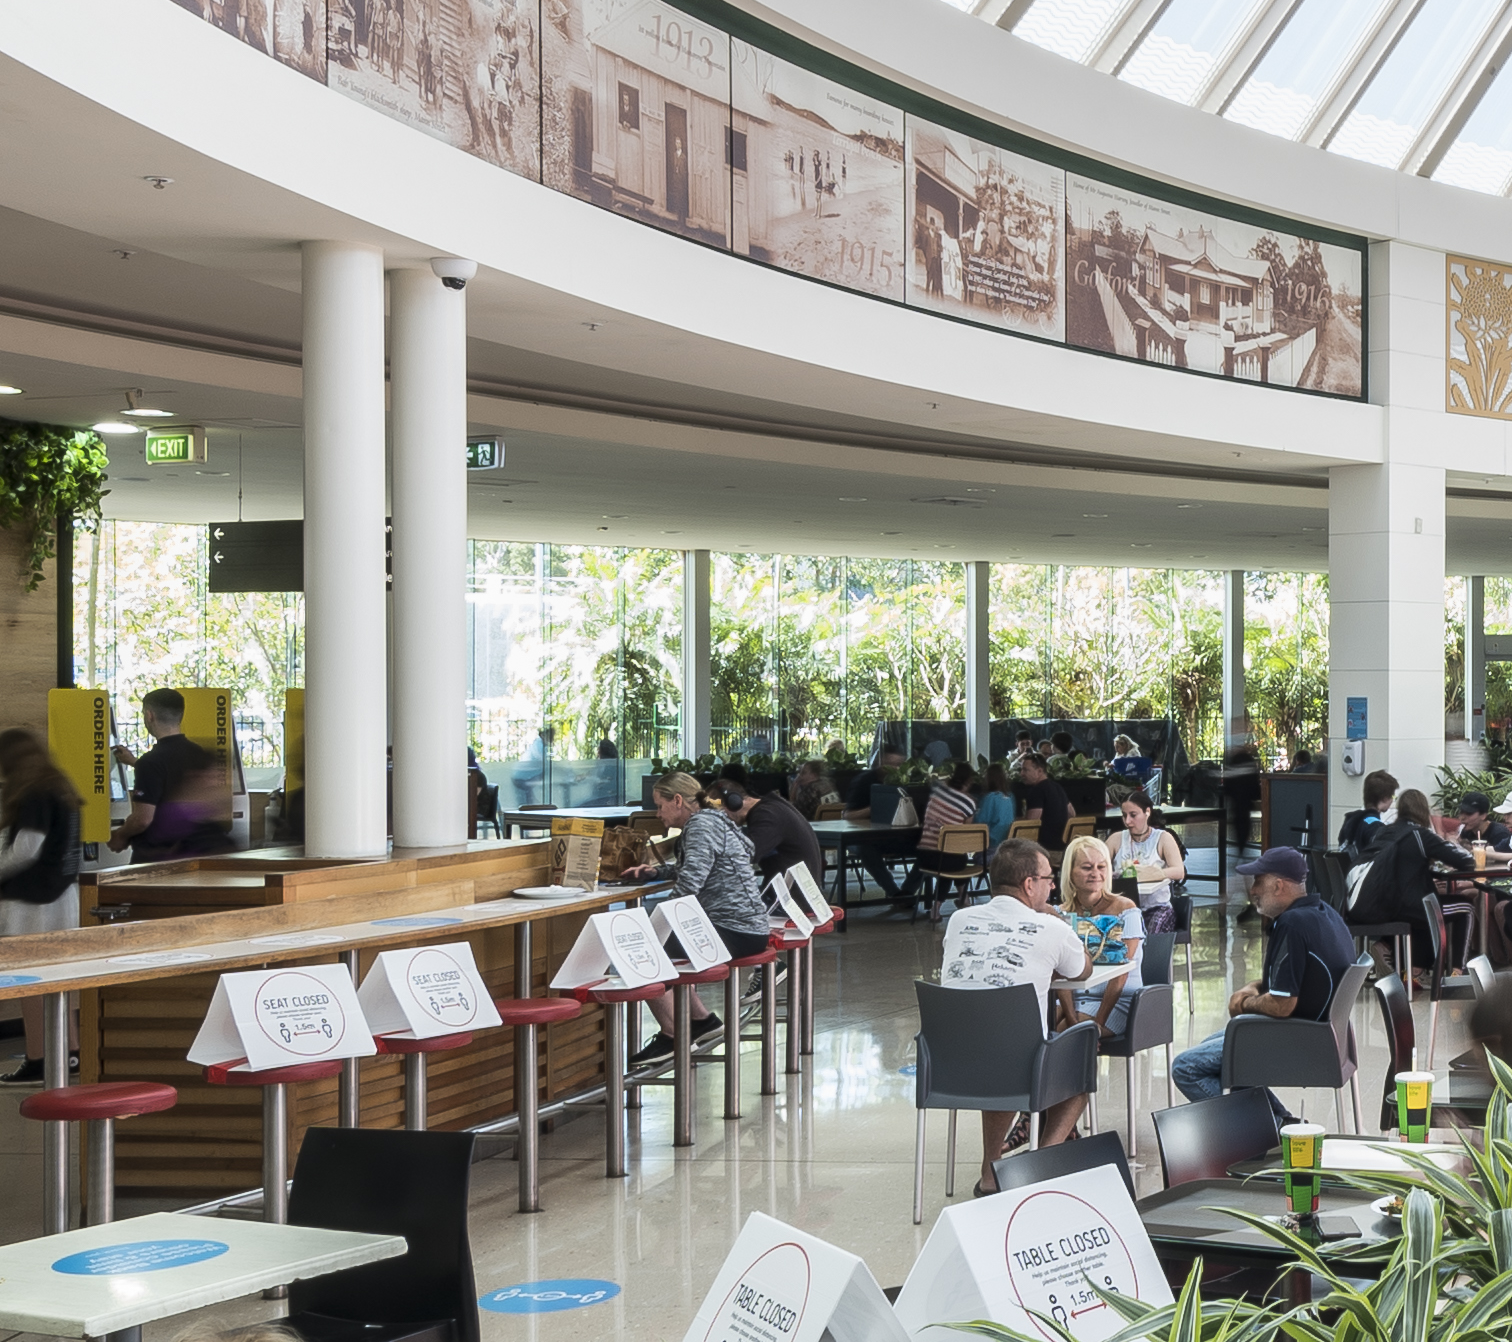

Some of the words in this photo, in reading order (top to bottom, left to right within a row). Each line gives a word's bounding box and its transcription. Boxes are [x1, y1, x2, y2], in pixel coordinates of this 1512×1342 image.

[651, 14, 714, 80] 1913
[837, 236, 894, 287] 1915
[1074, 258, 1144, 298] Gosford
[1288, 279, 1332, 314] 1916
[157, 439, 186, 458] EXIT
[93, 697, 105, 752] ORDER
[216, 695, 227, 746] ORDER
[93, 754, 105, 795] HERE
[412, 974, 431, 985] SEAT
[432, 970, 460, 982] CLOSED
[263, 997, 290, 1010] SEAT
[292, 994, 329, 1007] CLOSED
[1013, 1243, 1058, 1271] TABLE
[1061, 1226, 1111, 1257] CLOSED
[733, 1282, 765, 1315] TABLE
[759, 1297, 797, 1334] CLOSED
[1069, 1287, 1098, 1307] 1.5m
